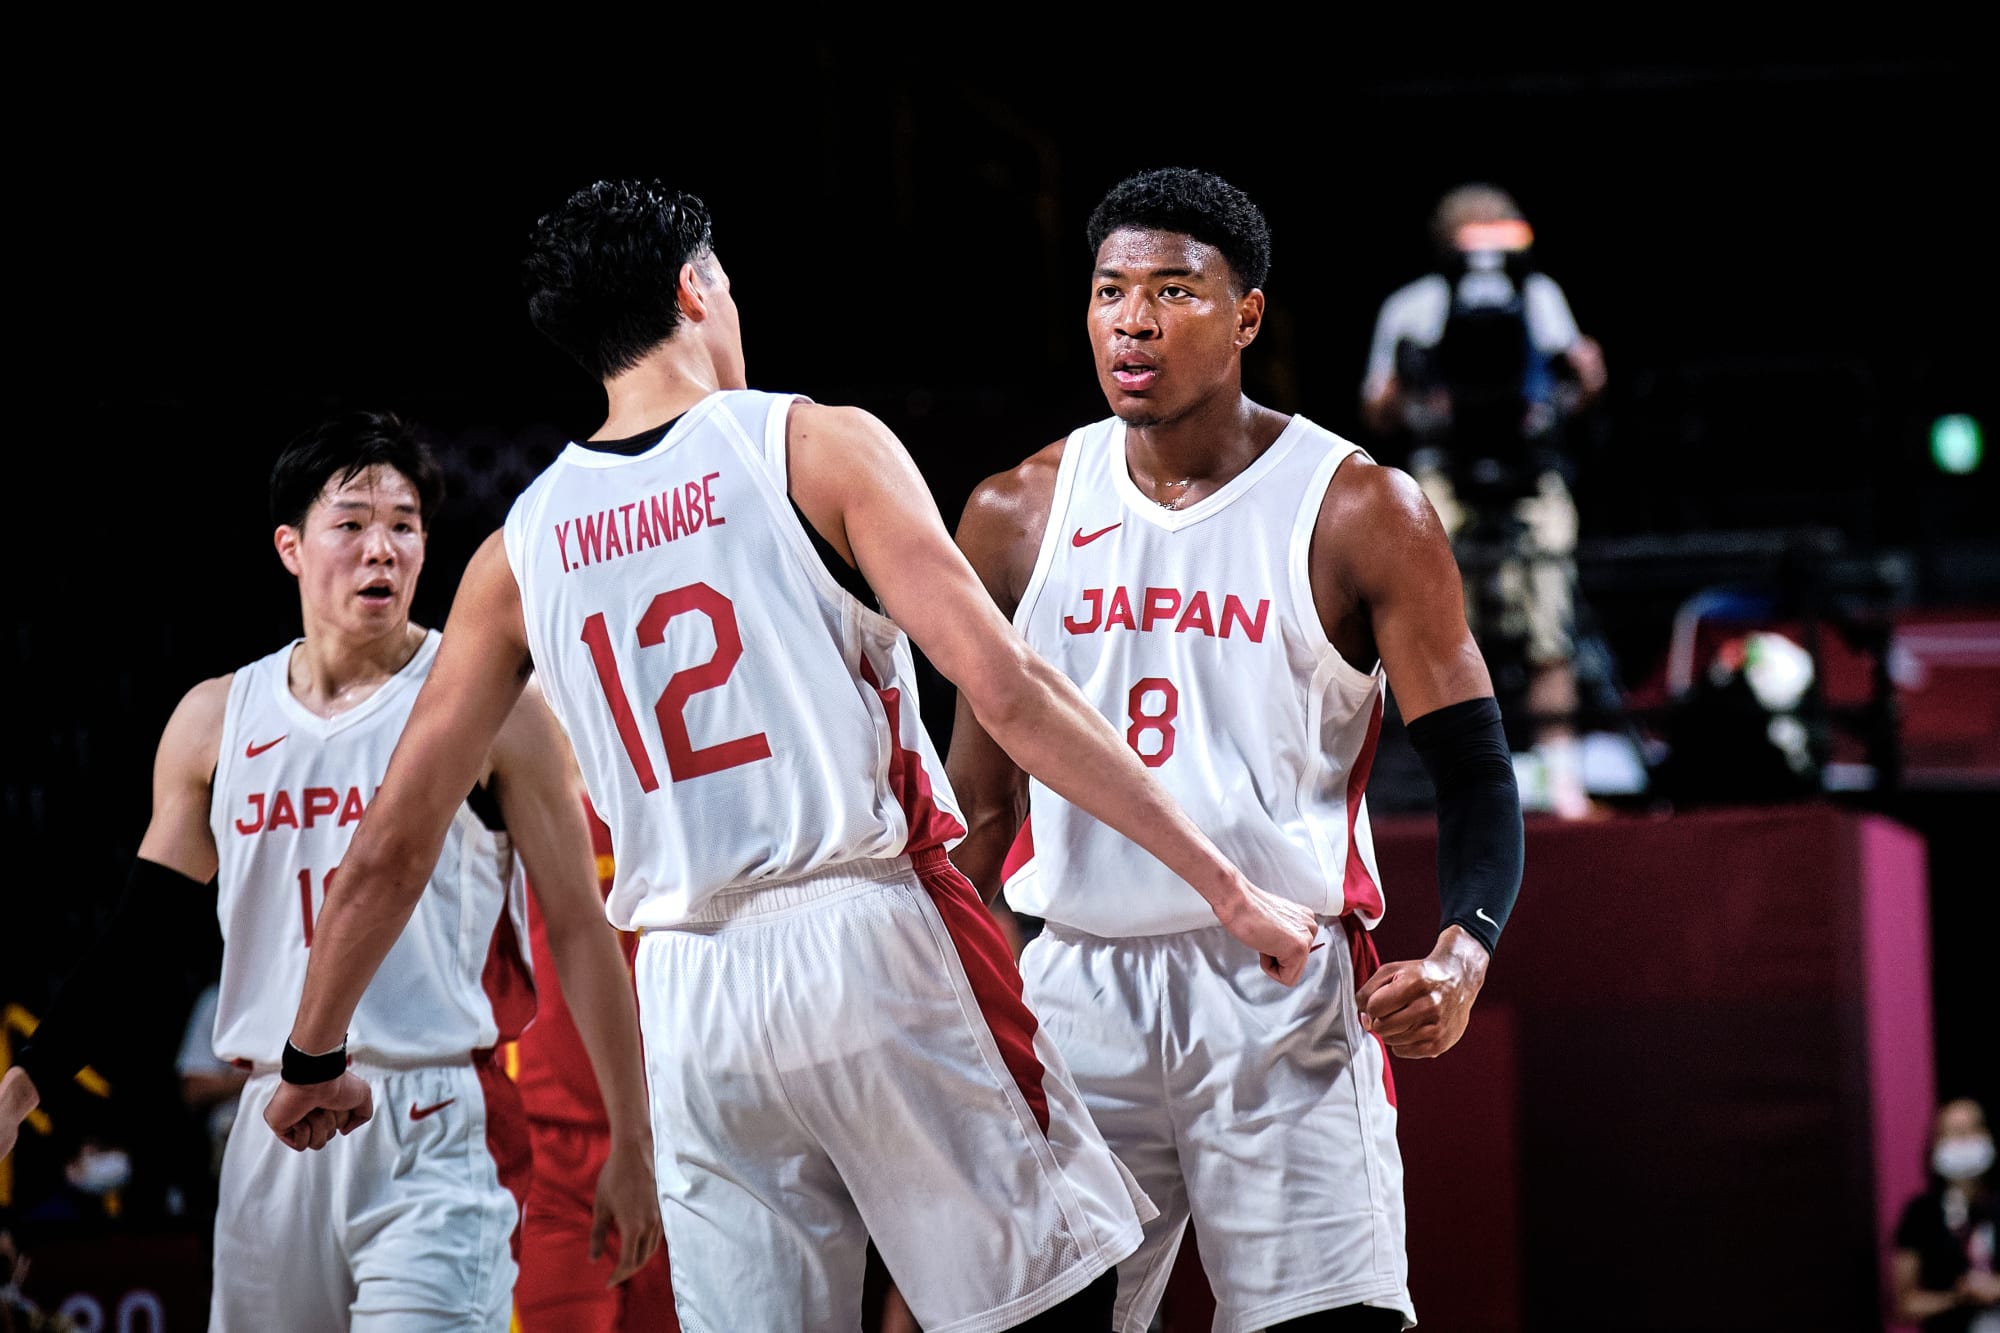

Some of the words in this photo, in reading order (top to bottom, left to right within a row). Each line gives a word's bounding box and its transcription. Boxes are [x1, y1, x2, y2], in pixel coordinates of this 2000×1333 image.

[555, 471, 725, 573] Y.WATANABE
[1064, 586, 1270, 643] JAPAN
[581, 581, 772, 794] 12
[1127, 677, 1178, 767] 8
[236, 786, 381, 835] JAPA
[297, 868, 338, 948] 1
